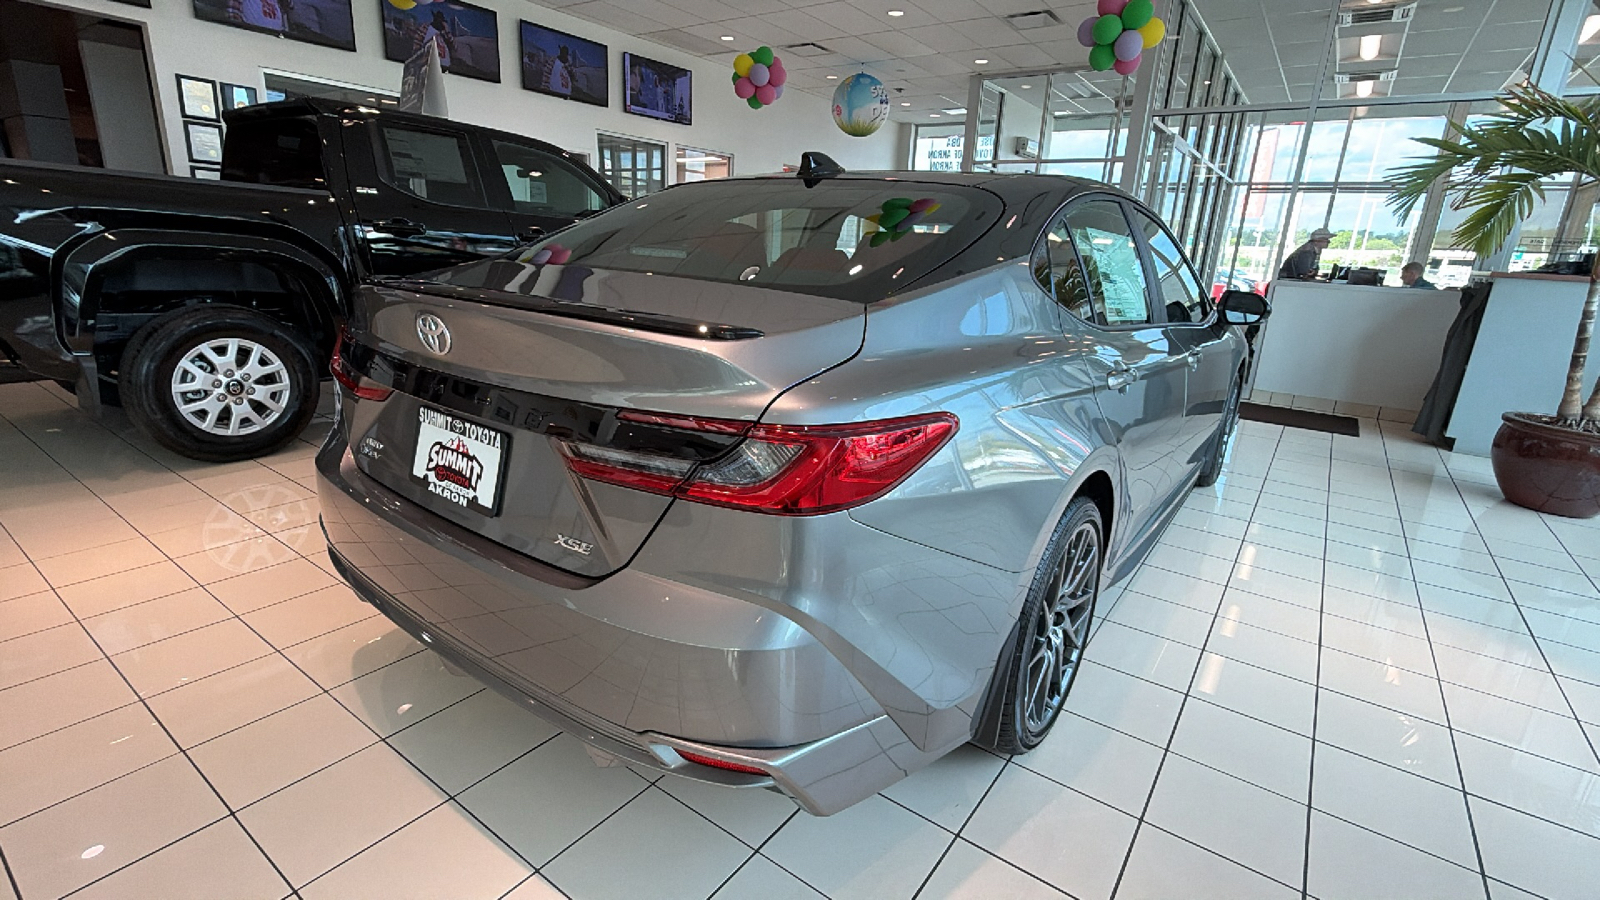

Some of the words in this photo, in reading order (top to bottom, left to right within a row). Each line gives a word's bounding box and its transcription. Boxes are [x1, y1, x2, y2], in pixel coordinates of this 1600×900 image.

[419, 406, 452, 431] SUMMIT
[465, 421, 501, 449] TOYOTA
[427, 444, 482, 488] SUMMIT
[446, 471, 469, 488] TOYOTA
[428, 482, 468, 507] AKRON
[553, 532, 594, 555] XSE
